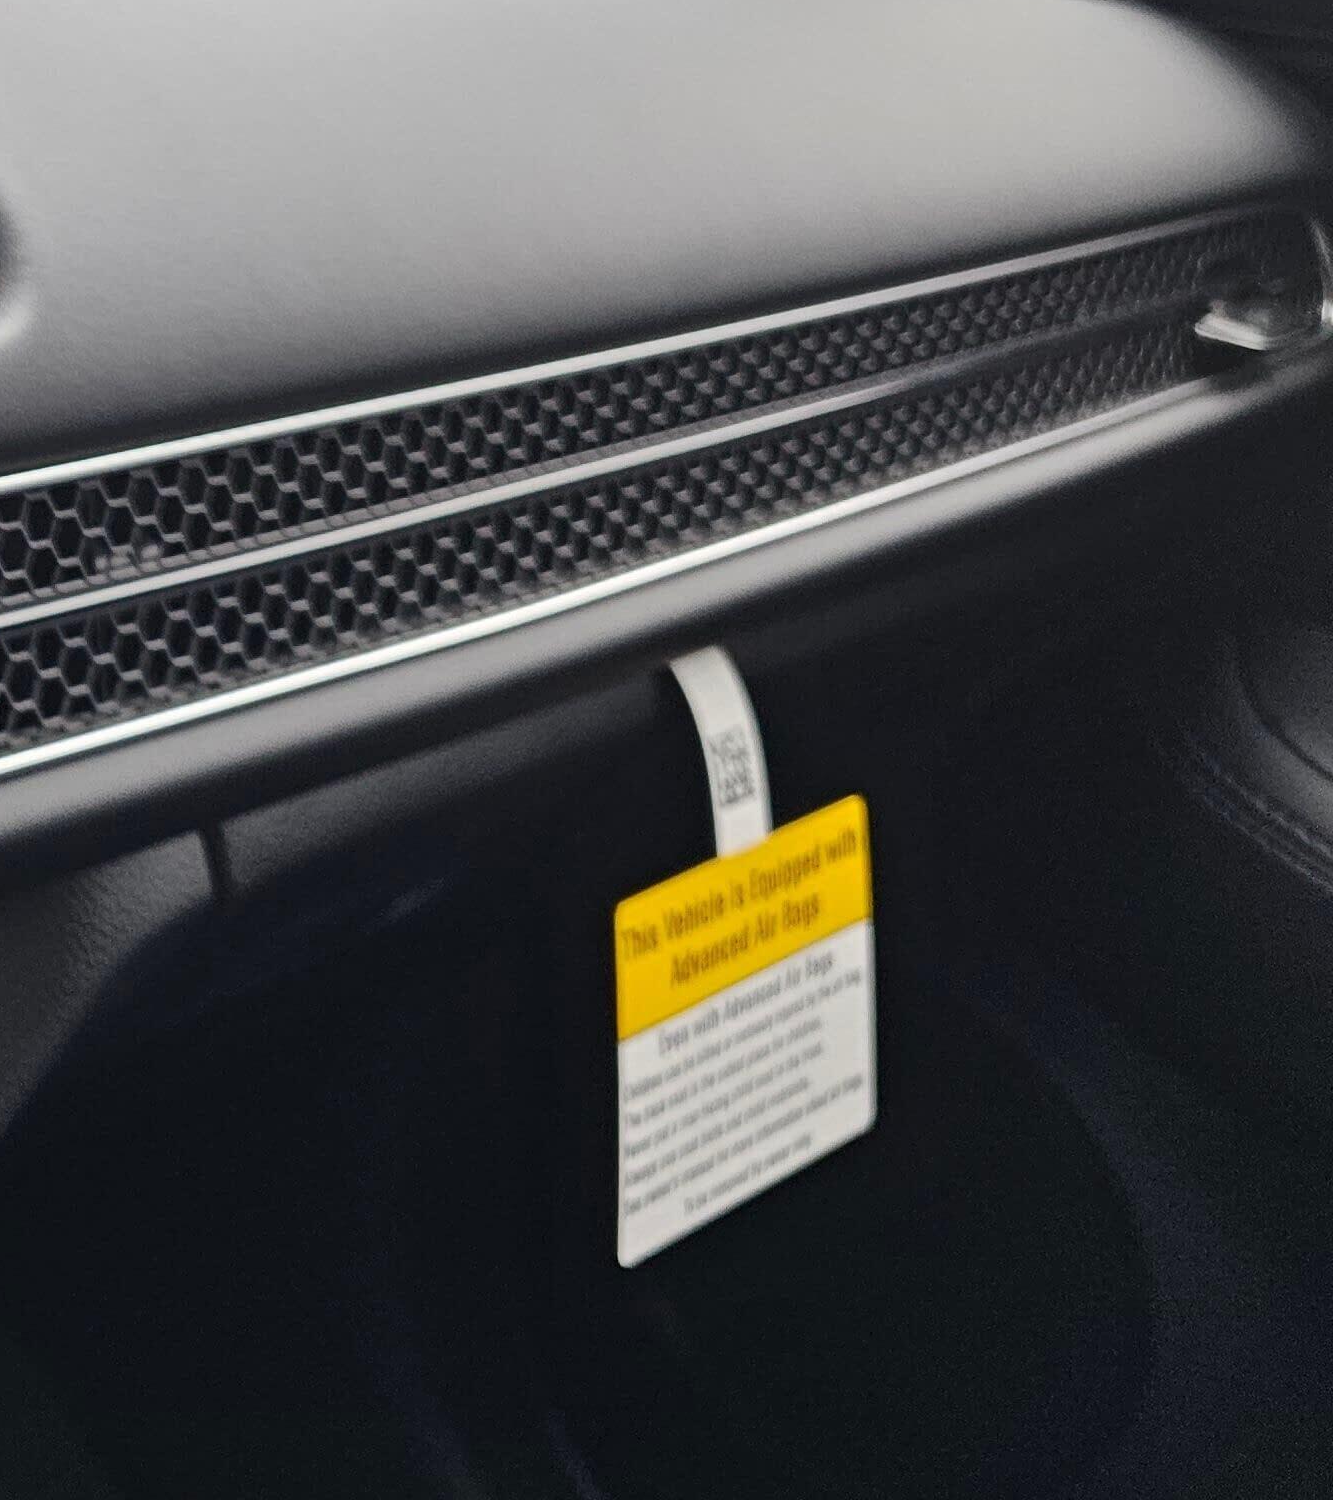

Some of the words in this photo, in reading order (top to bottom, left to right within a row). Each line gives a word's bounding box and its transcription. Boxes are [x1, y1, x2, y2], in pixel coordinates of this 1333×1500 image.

[621, 924, 659, 959] This
[662, 891, 725, 939] Vehicle
[748, 846, 821, 901] Equipped
[824, 827, 857, 865] with
[670, 926, 750, 988] Advanced
[753, 911, 779, 946] Air
[783, 893, 820, 930] Bags
